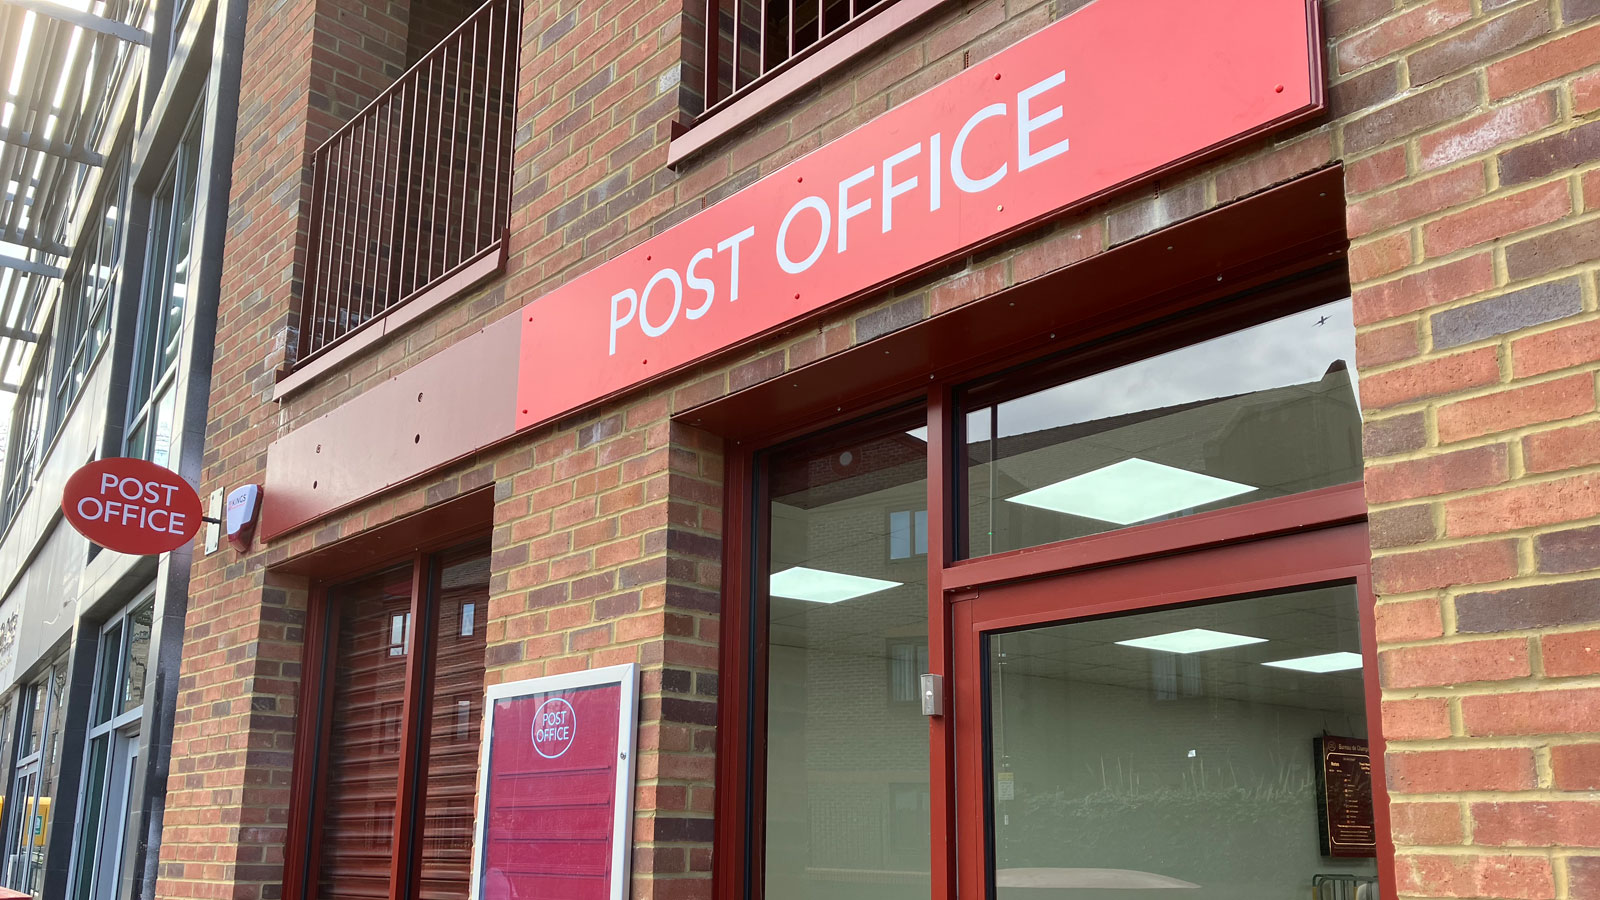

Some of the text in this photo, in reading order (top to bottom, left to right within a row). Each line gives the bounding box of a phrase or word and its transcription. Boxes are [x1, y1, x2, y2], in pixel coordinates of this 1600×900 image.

[608, 69, 1070, 356] POST OFFICE
[100, 472, 179, 507] POST
[77, 496, 186, 535] OFFICE
[536, 726, 569, 742] OFFICE
[543, 711, 567, 726] POST
